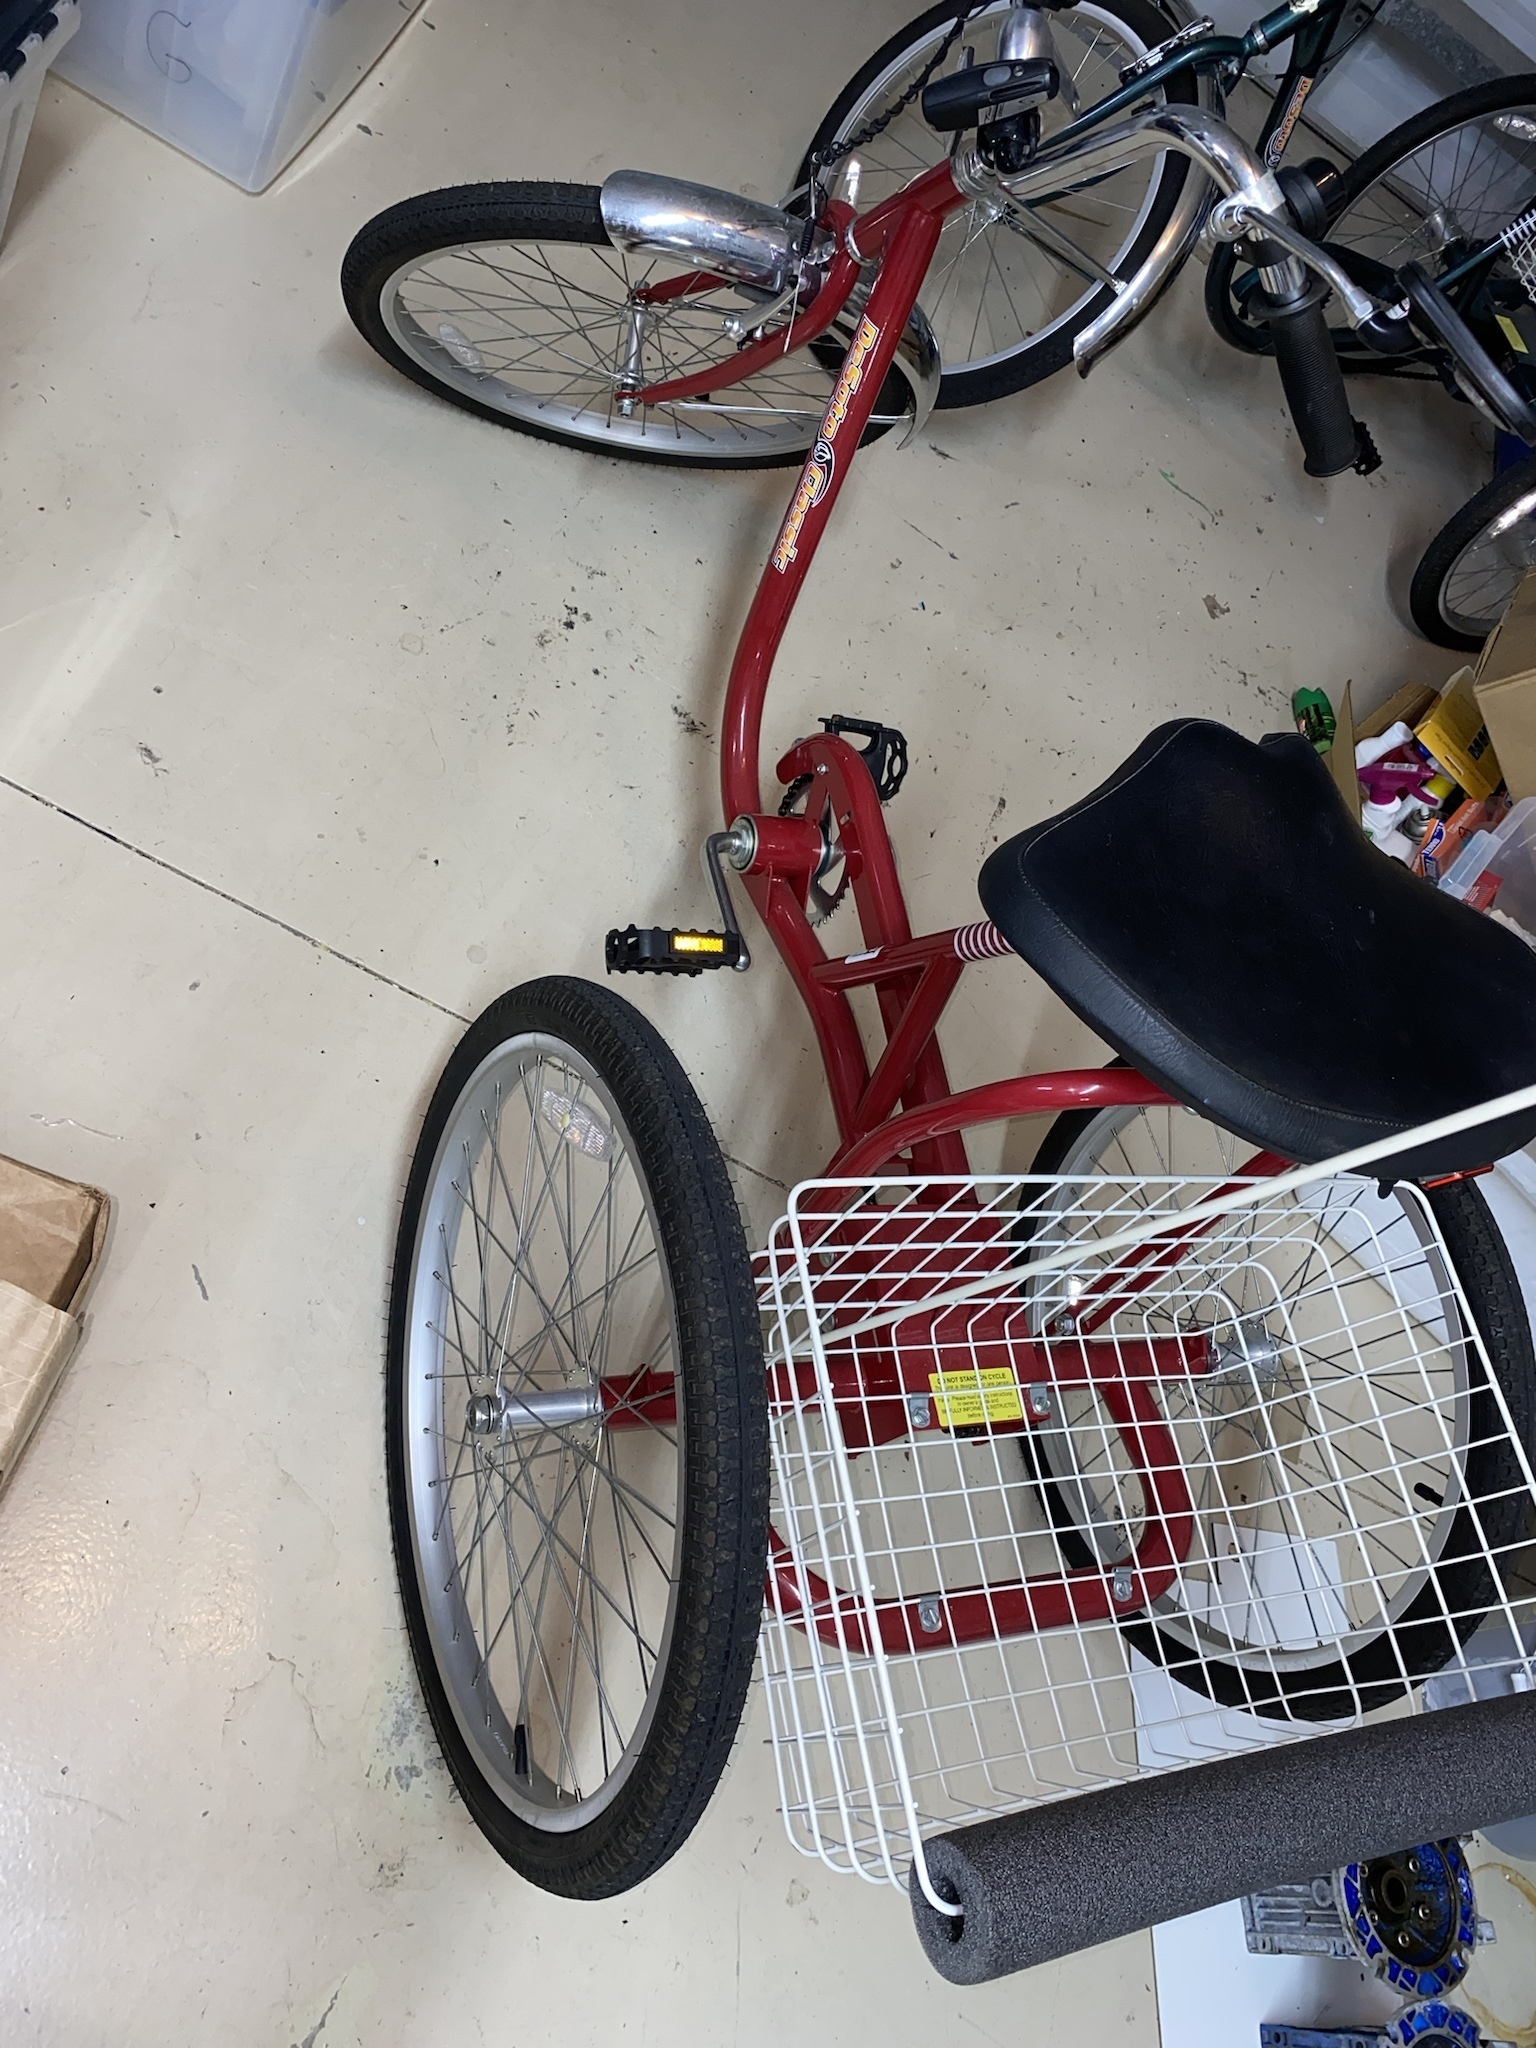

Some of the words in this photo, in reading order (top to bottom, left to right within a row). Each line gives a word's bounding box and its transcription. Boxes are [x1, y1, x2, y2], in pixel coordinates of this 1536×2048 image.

[821, 313, 880, 439] DeSoto
[772, 461, 824, 574] Classic
[987, 1372, 1007, 1380] CYCLE
